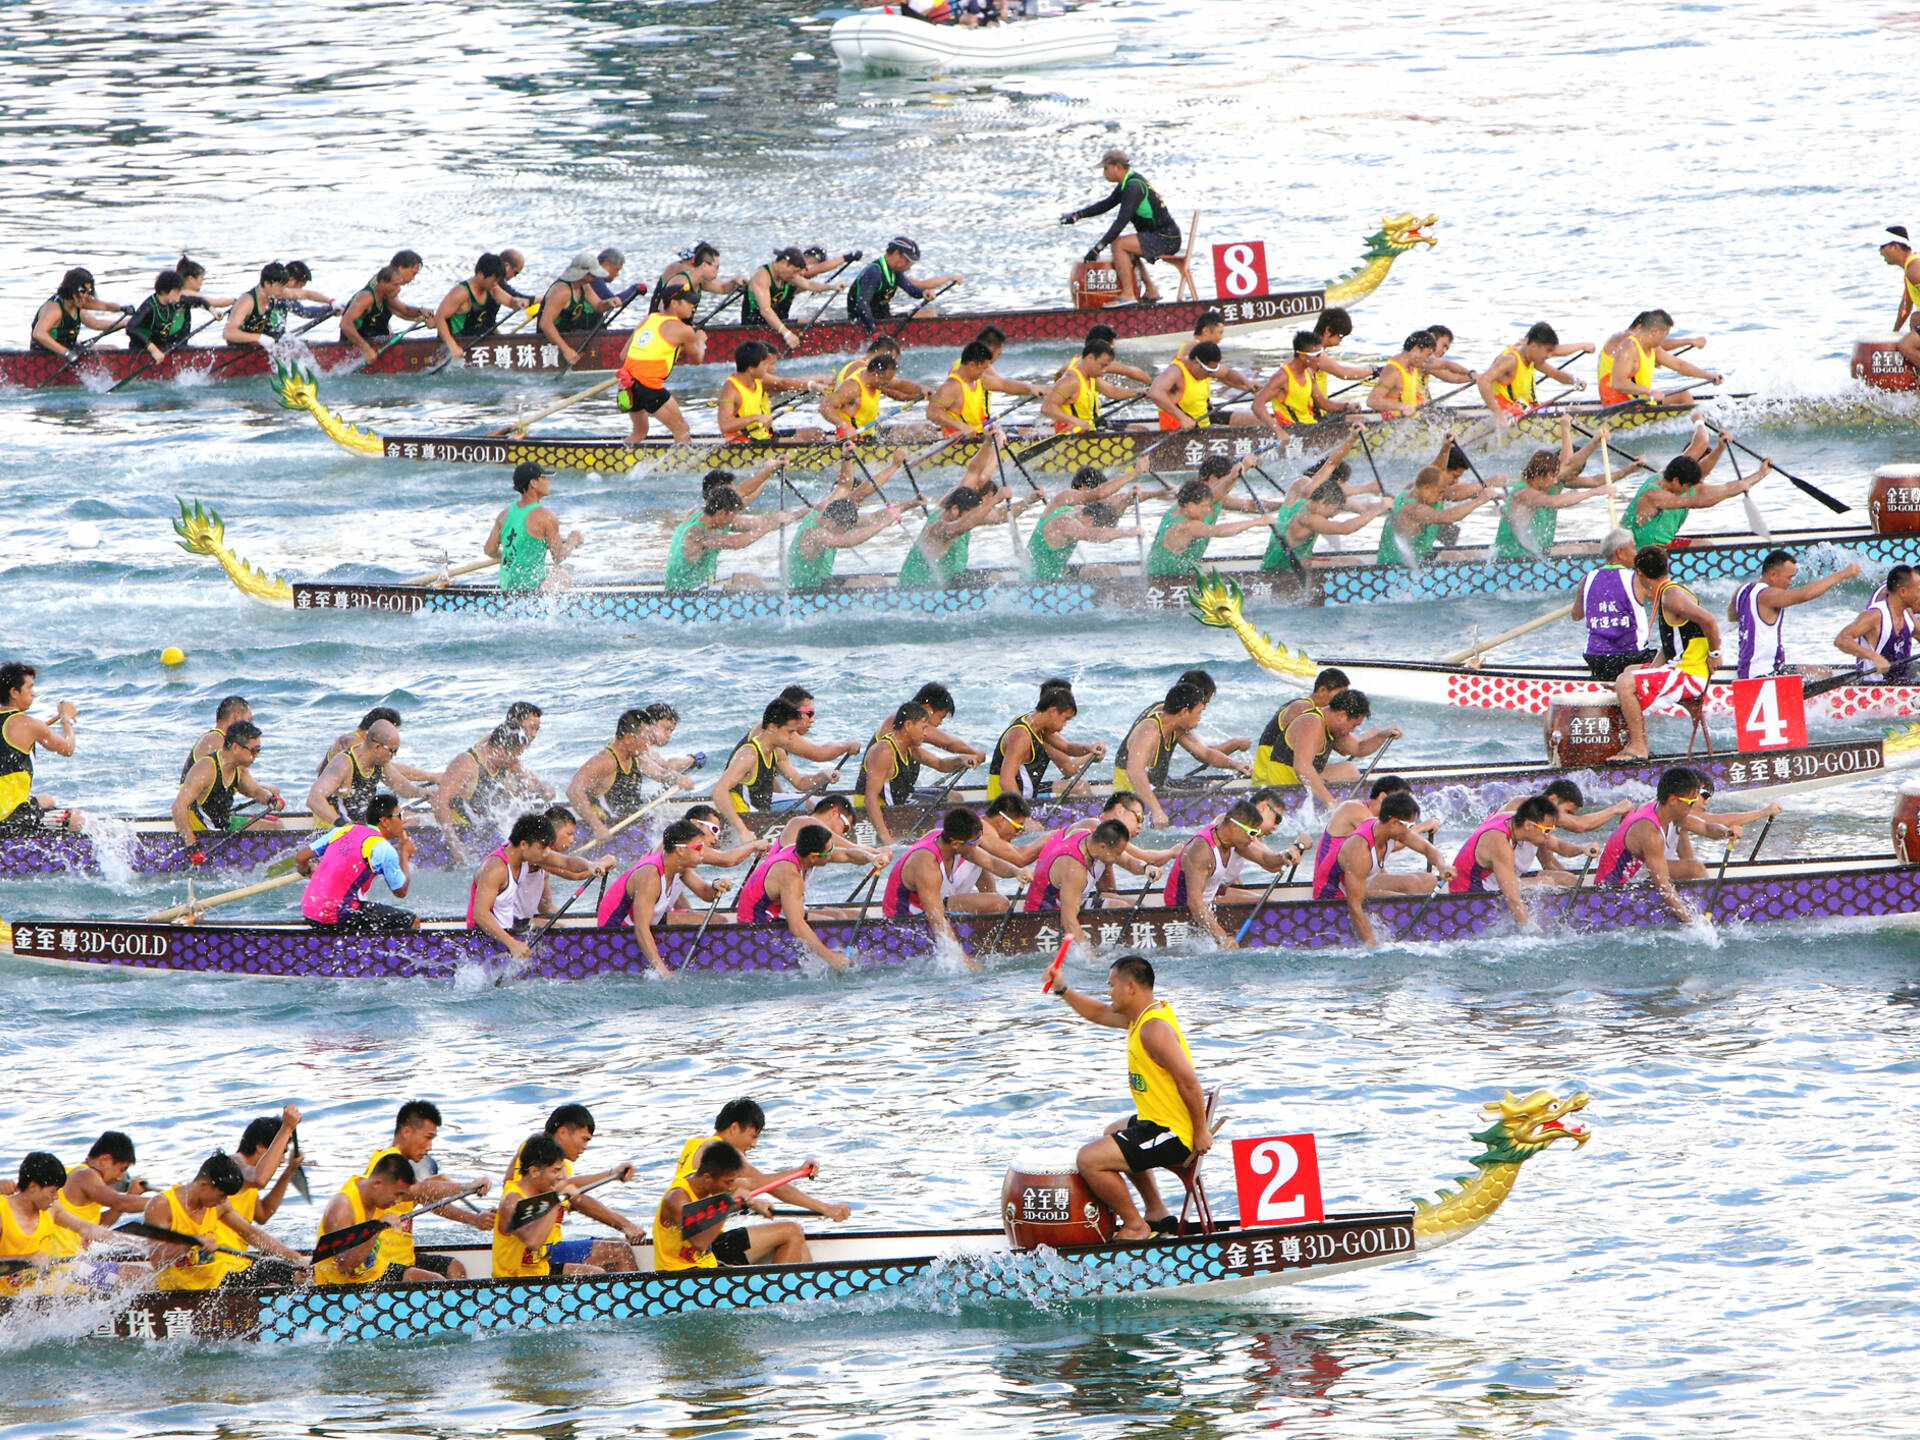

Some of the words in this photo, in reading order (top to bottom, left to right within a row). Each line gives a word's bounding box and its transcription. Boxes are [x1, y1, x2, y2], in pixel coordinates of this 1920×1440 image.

[1223, 244, 1258, 296] 8
[461, 343, 560, 368] 至尊珠寶
[1745, 680, 1789, 746] 4
[1571, 717, 1611, 735] 金至尊
[1570, 735, 1611, 744] 3D-GOLD
[1250, 1140, 1305, 1221] 2
[1022, 1187, 1070, 1210] 金至尊
[1023, 1211, 1070, 1220] 3D-GOLD
